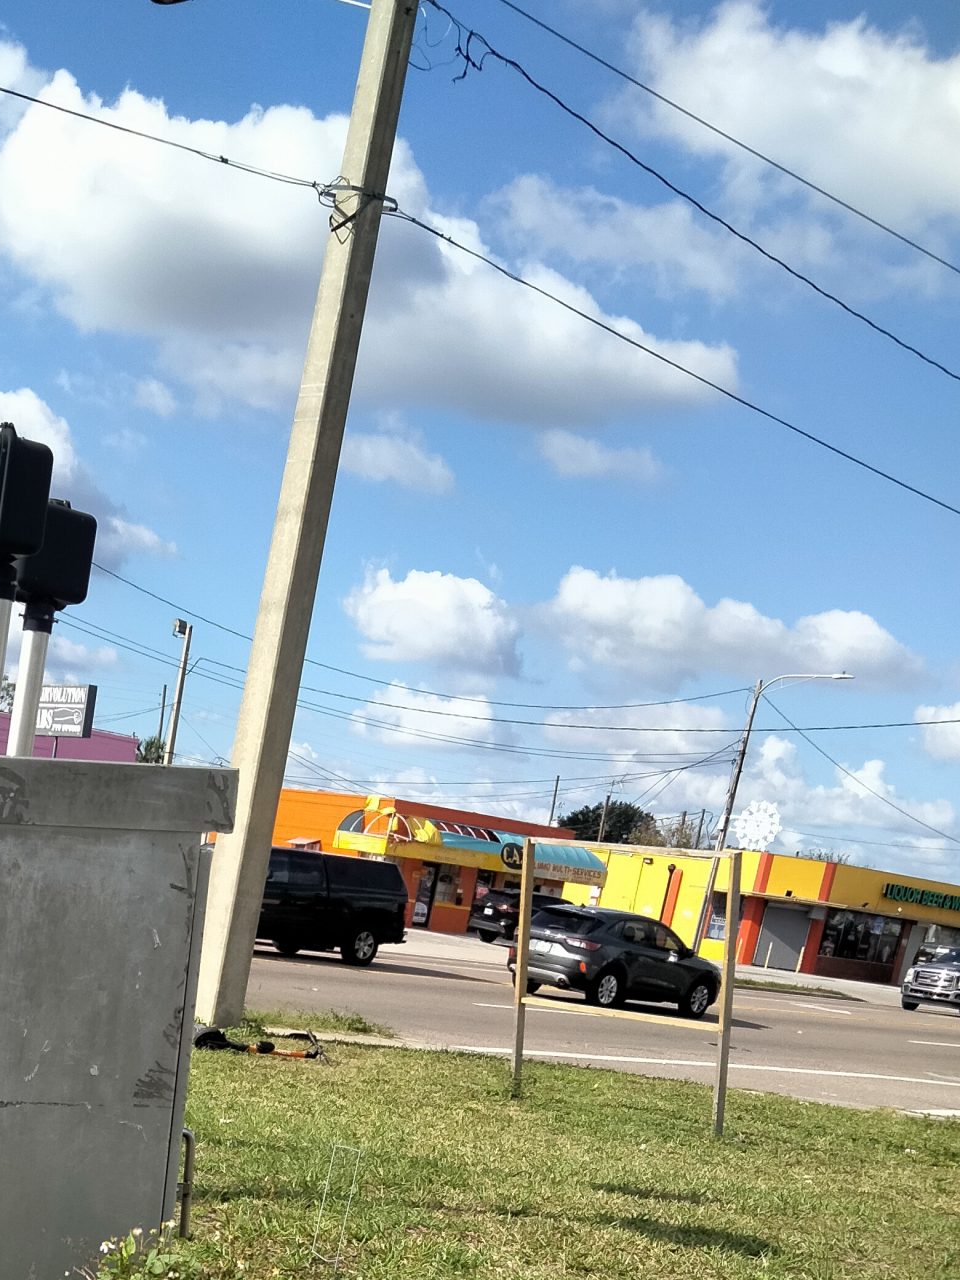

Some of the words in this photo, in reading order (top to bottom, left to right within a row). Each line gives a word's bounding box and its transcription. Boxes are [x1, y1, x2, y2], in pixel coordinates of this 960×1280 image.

[503, 846, 523, 866] CA
[886, 883, 921, 904] LIQUOR
[922, 889, 945, 908] BEER
